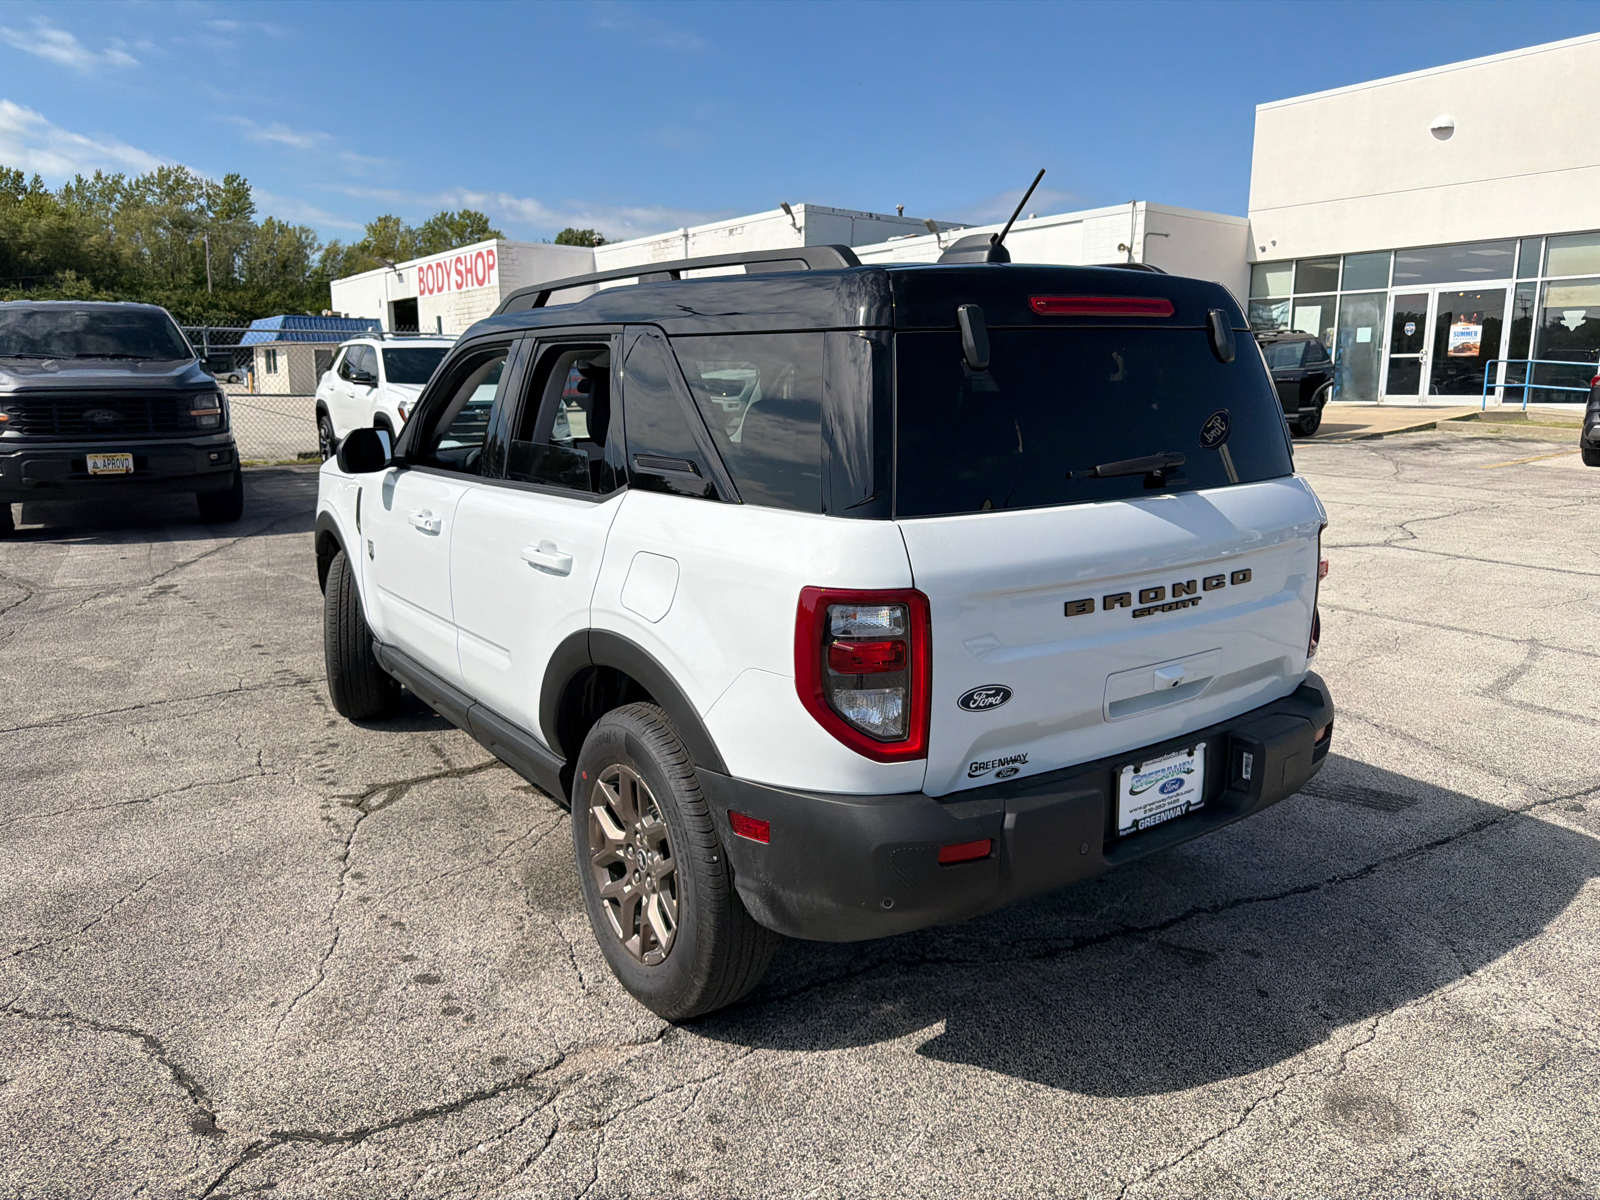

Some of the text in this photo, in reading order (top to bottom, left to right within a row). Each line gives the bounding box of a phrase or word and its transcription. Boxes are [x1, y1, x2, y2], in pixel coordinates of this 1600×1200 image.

[418, 249, 495, 296] BODY SHOP
[1453, 330, 1478, 338] SUMMER
[102, 458, 130, 469] APROVD
[1064, 568, 1252, 617] BRONCO
[1132, 596, 1202, 618] SPORT
[969, 689, 1004, 709] Ford
[969, 753, 1028, 774] GREENWAY
[1131, 759, 1194, 790] GREENWAY
[1138, 804, 1188, 830] GREENWAY
